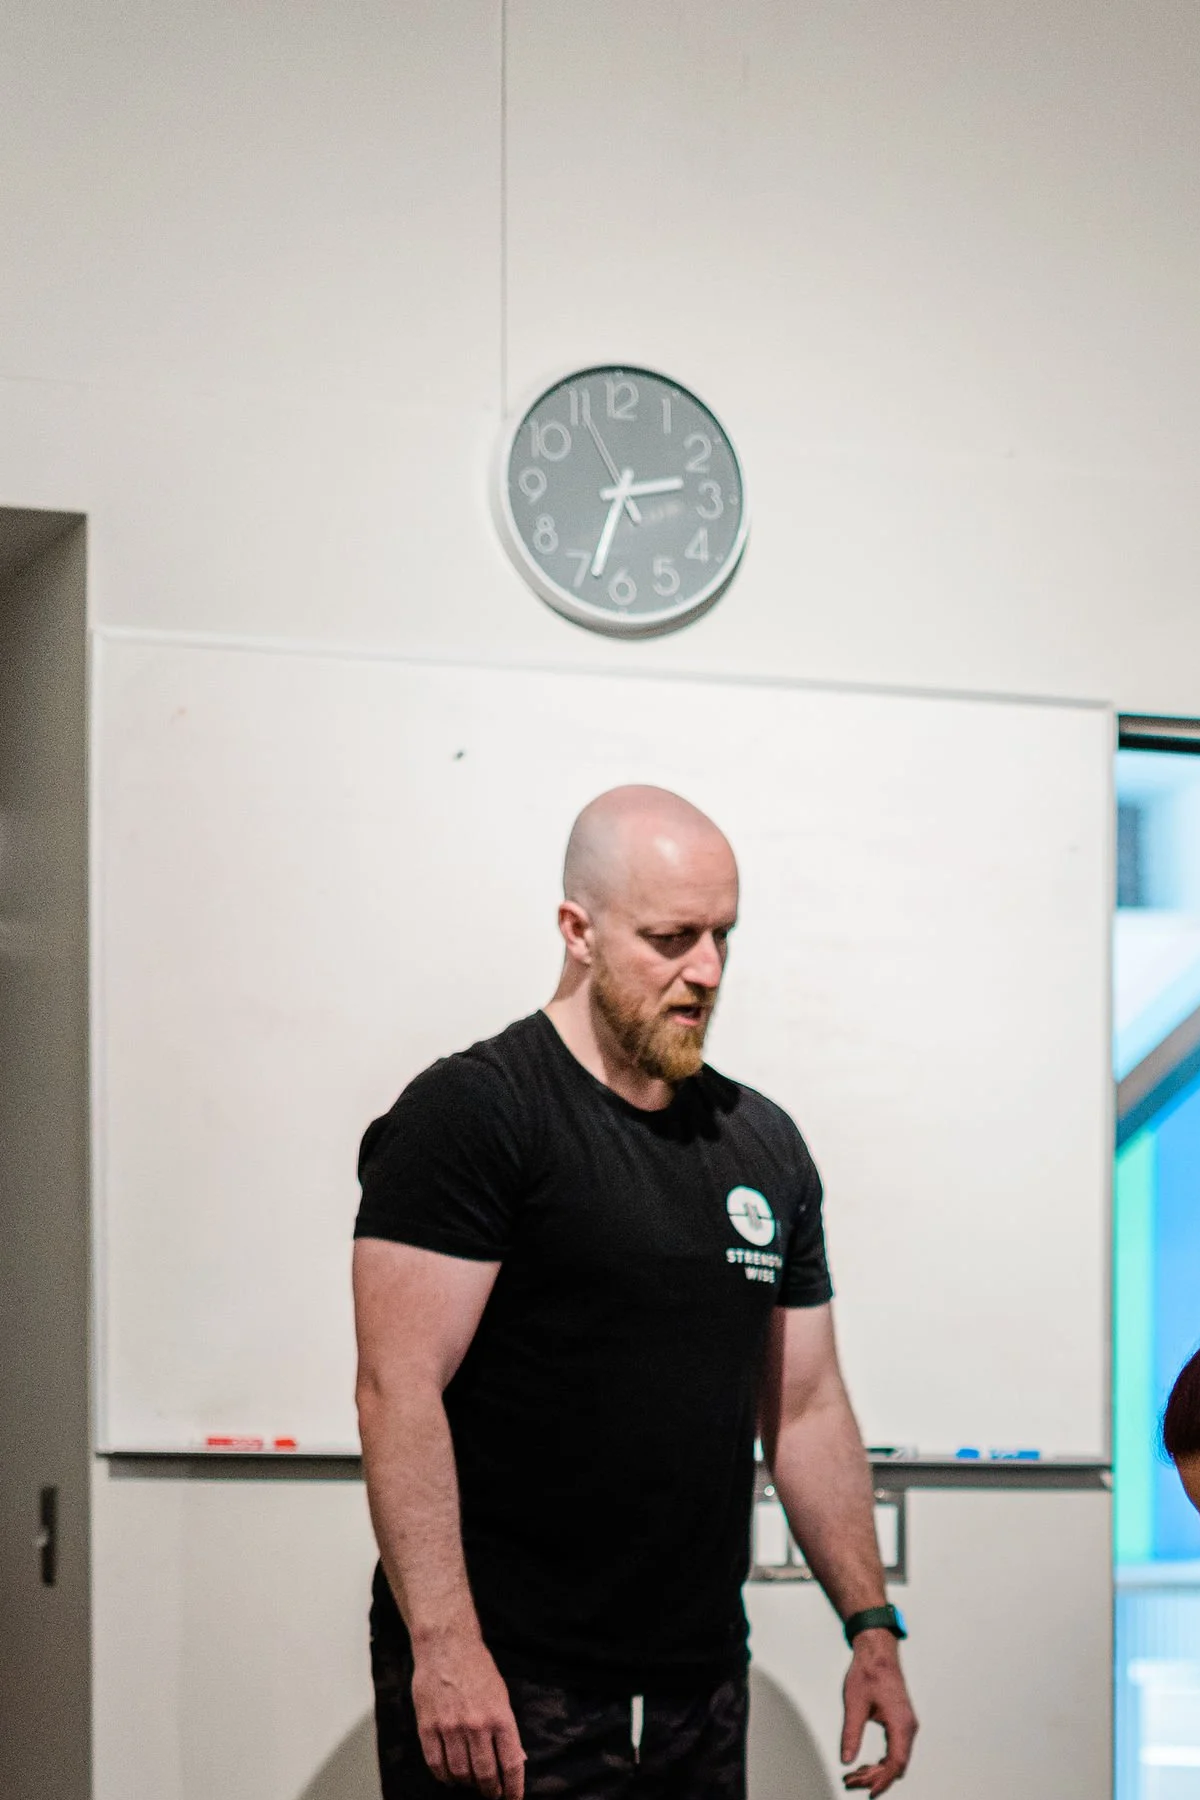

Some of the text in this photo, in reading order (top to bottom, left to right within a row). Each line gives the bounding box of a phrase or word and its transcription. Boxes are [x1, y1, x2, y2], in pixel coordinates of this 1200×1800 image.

[604, 378, 640, 420] 12
[662, 398, 672, 434] 1
[529, 419, 572, 462] 10
[684, 433, 713, 473] 2
[518, 466, 547, 504] 9
[695, 479, 724, 520] 3
[532, 513, 559, 555] 8
[684, 527, 710, 563] 4
[565, 549, 592, 588] 7
[607, 567, 638, 606] 6
[652, 555, 681, 597] 5
